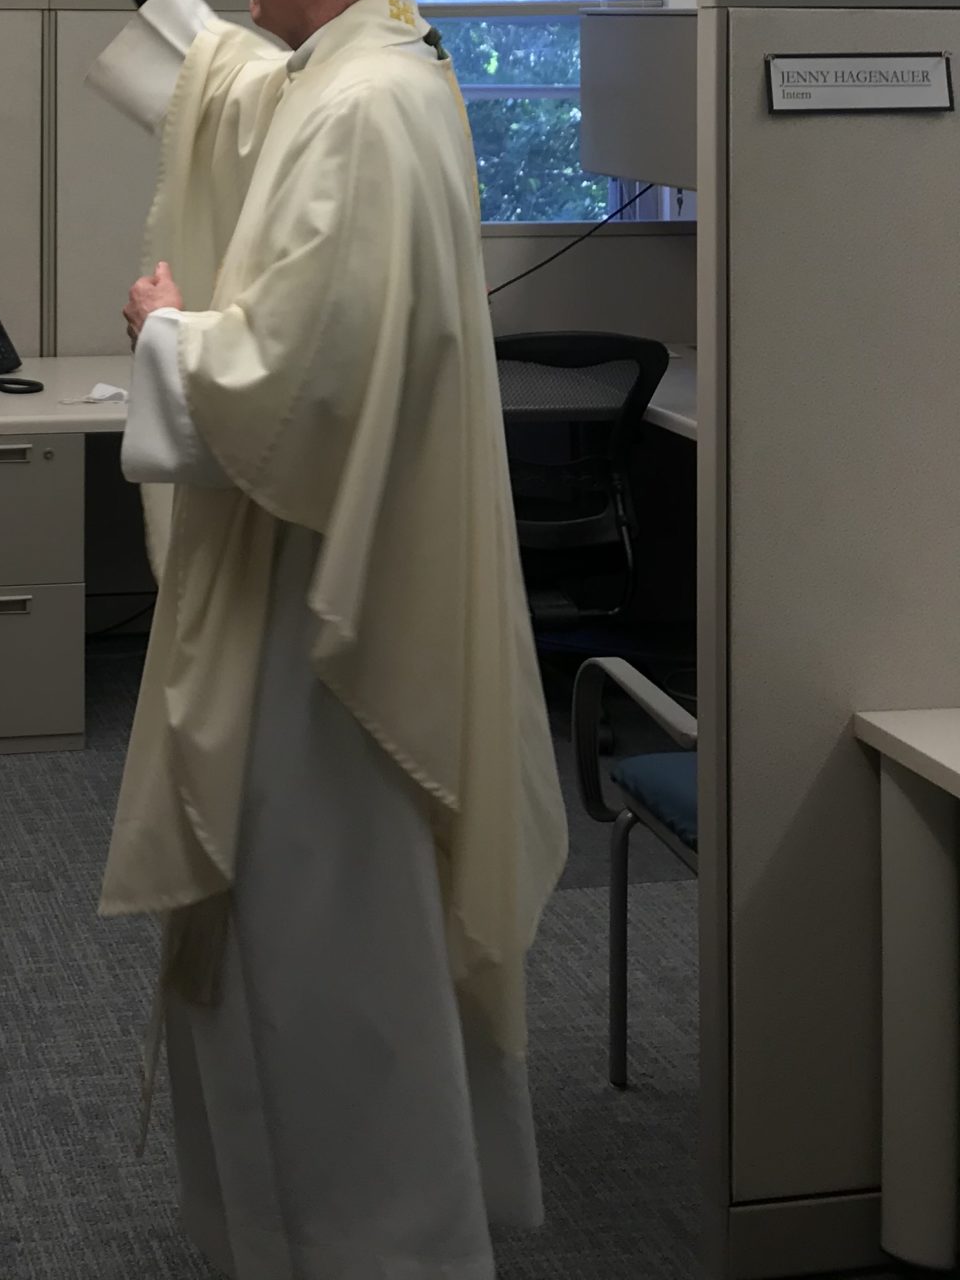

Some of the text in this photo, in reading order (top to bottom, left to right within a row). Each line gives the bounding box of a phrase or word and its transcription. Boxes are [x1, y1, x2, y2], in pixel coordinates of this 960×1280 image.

[780, 70, 931, 86] JENNY HAGENAUER
[782, 89, 812, 100] Intern
